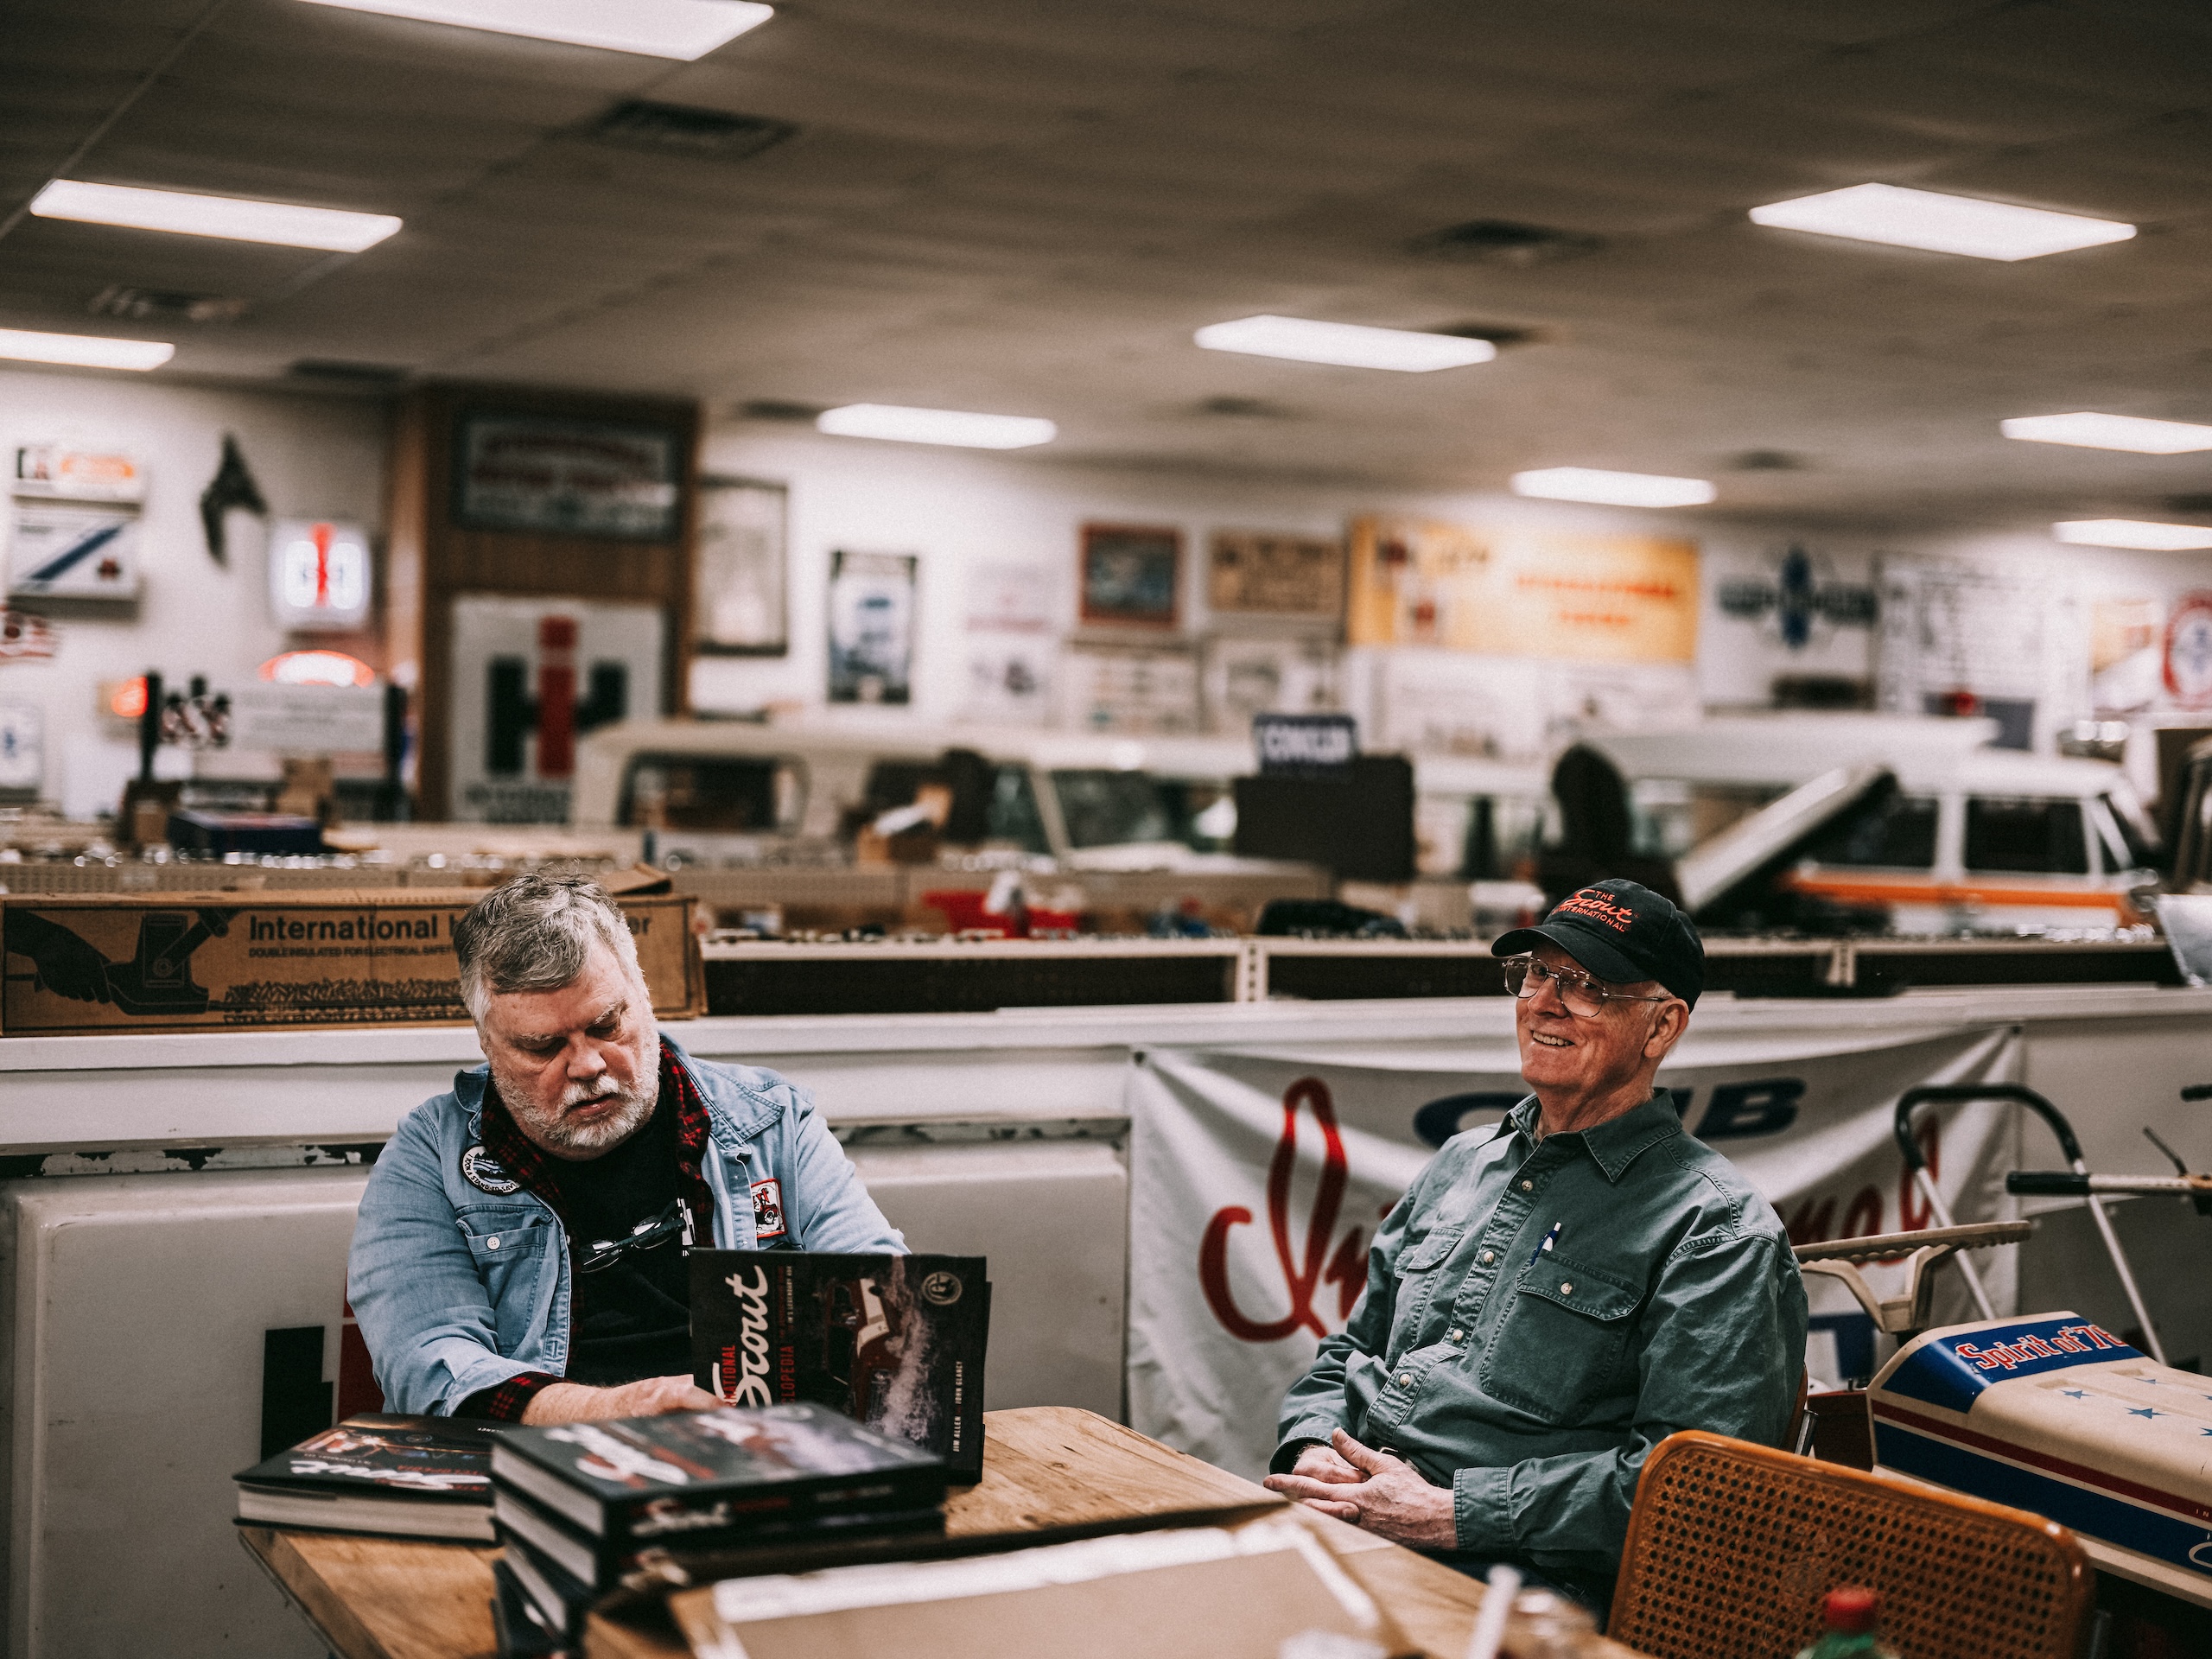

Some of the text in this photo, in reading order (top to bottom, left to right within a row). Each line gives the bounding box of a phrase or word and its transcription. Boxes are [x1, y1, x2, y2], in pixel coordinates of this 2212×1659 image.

[1558, 888, 1633, 924] Scout
[1596, 890, 1616, 901] THE
[250, 914, 438, 941] International
[470, 1175, 490, 1190] STAND
[712, 1265, 772, 1409] Scout
[1955, 1335, 2063, 1370] Spirit
[2050, 1325, 2092, 1353] of
